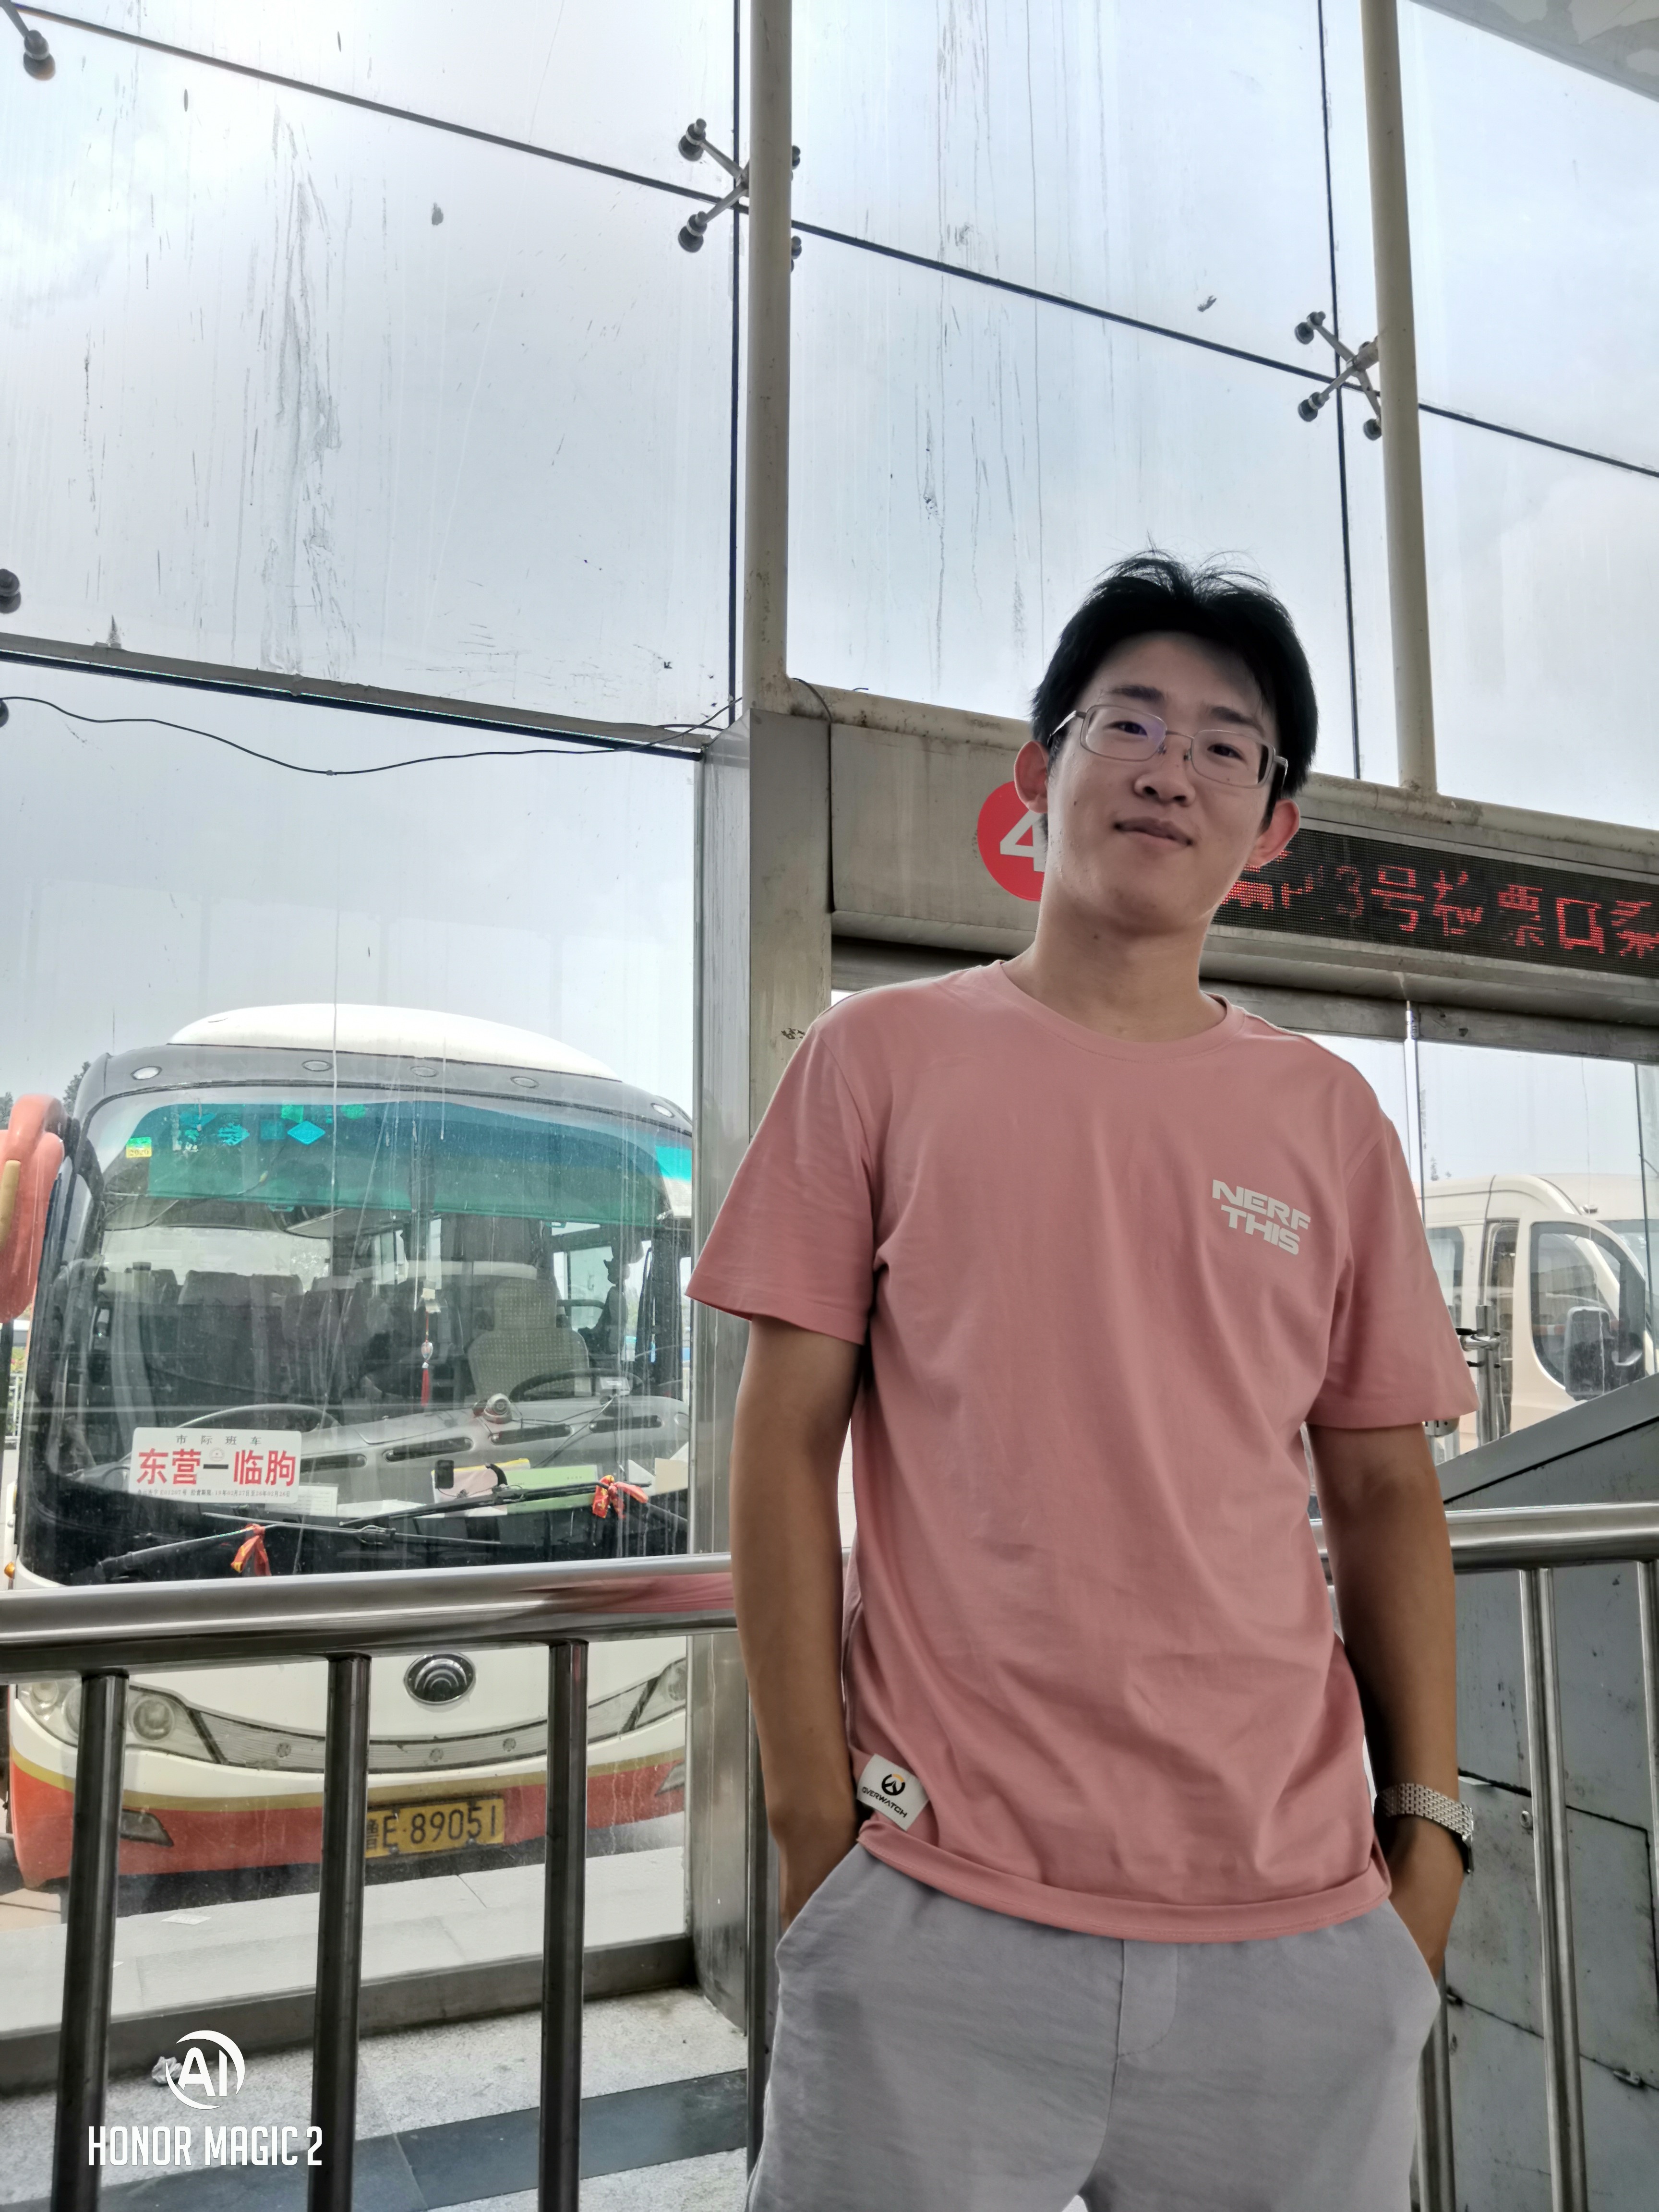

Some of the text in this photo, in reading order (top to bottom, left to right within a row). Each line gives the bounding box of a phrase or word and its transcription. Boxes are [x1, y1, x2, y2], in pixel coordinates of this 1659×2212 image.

[1000, 810, 1047, 872] 4
[1212, 1179, 1311, 1230] NERF
[1221, 1204, 1300, 1255] THIS
[176, 1434, 261, 1445] 市际班车
[862, 1787, 907, 1818] OVERWATCH
